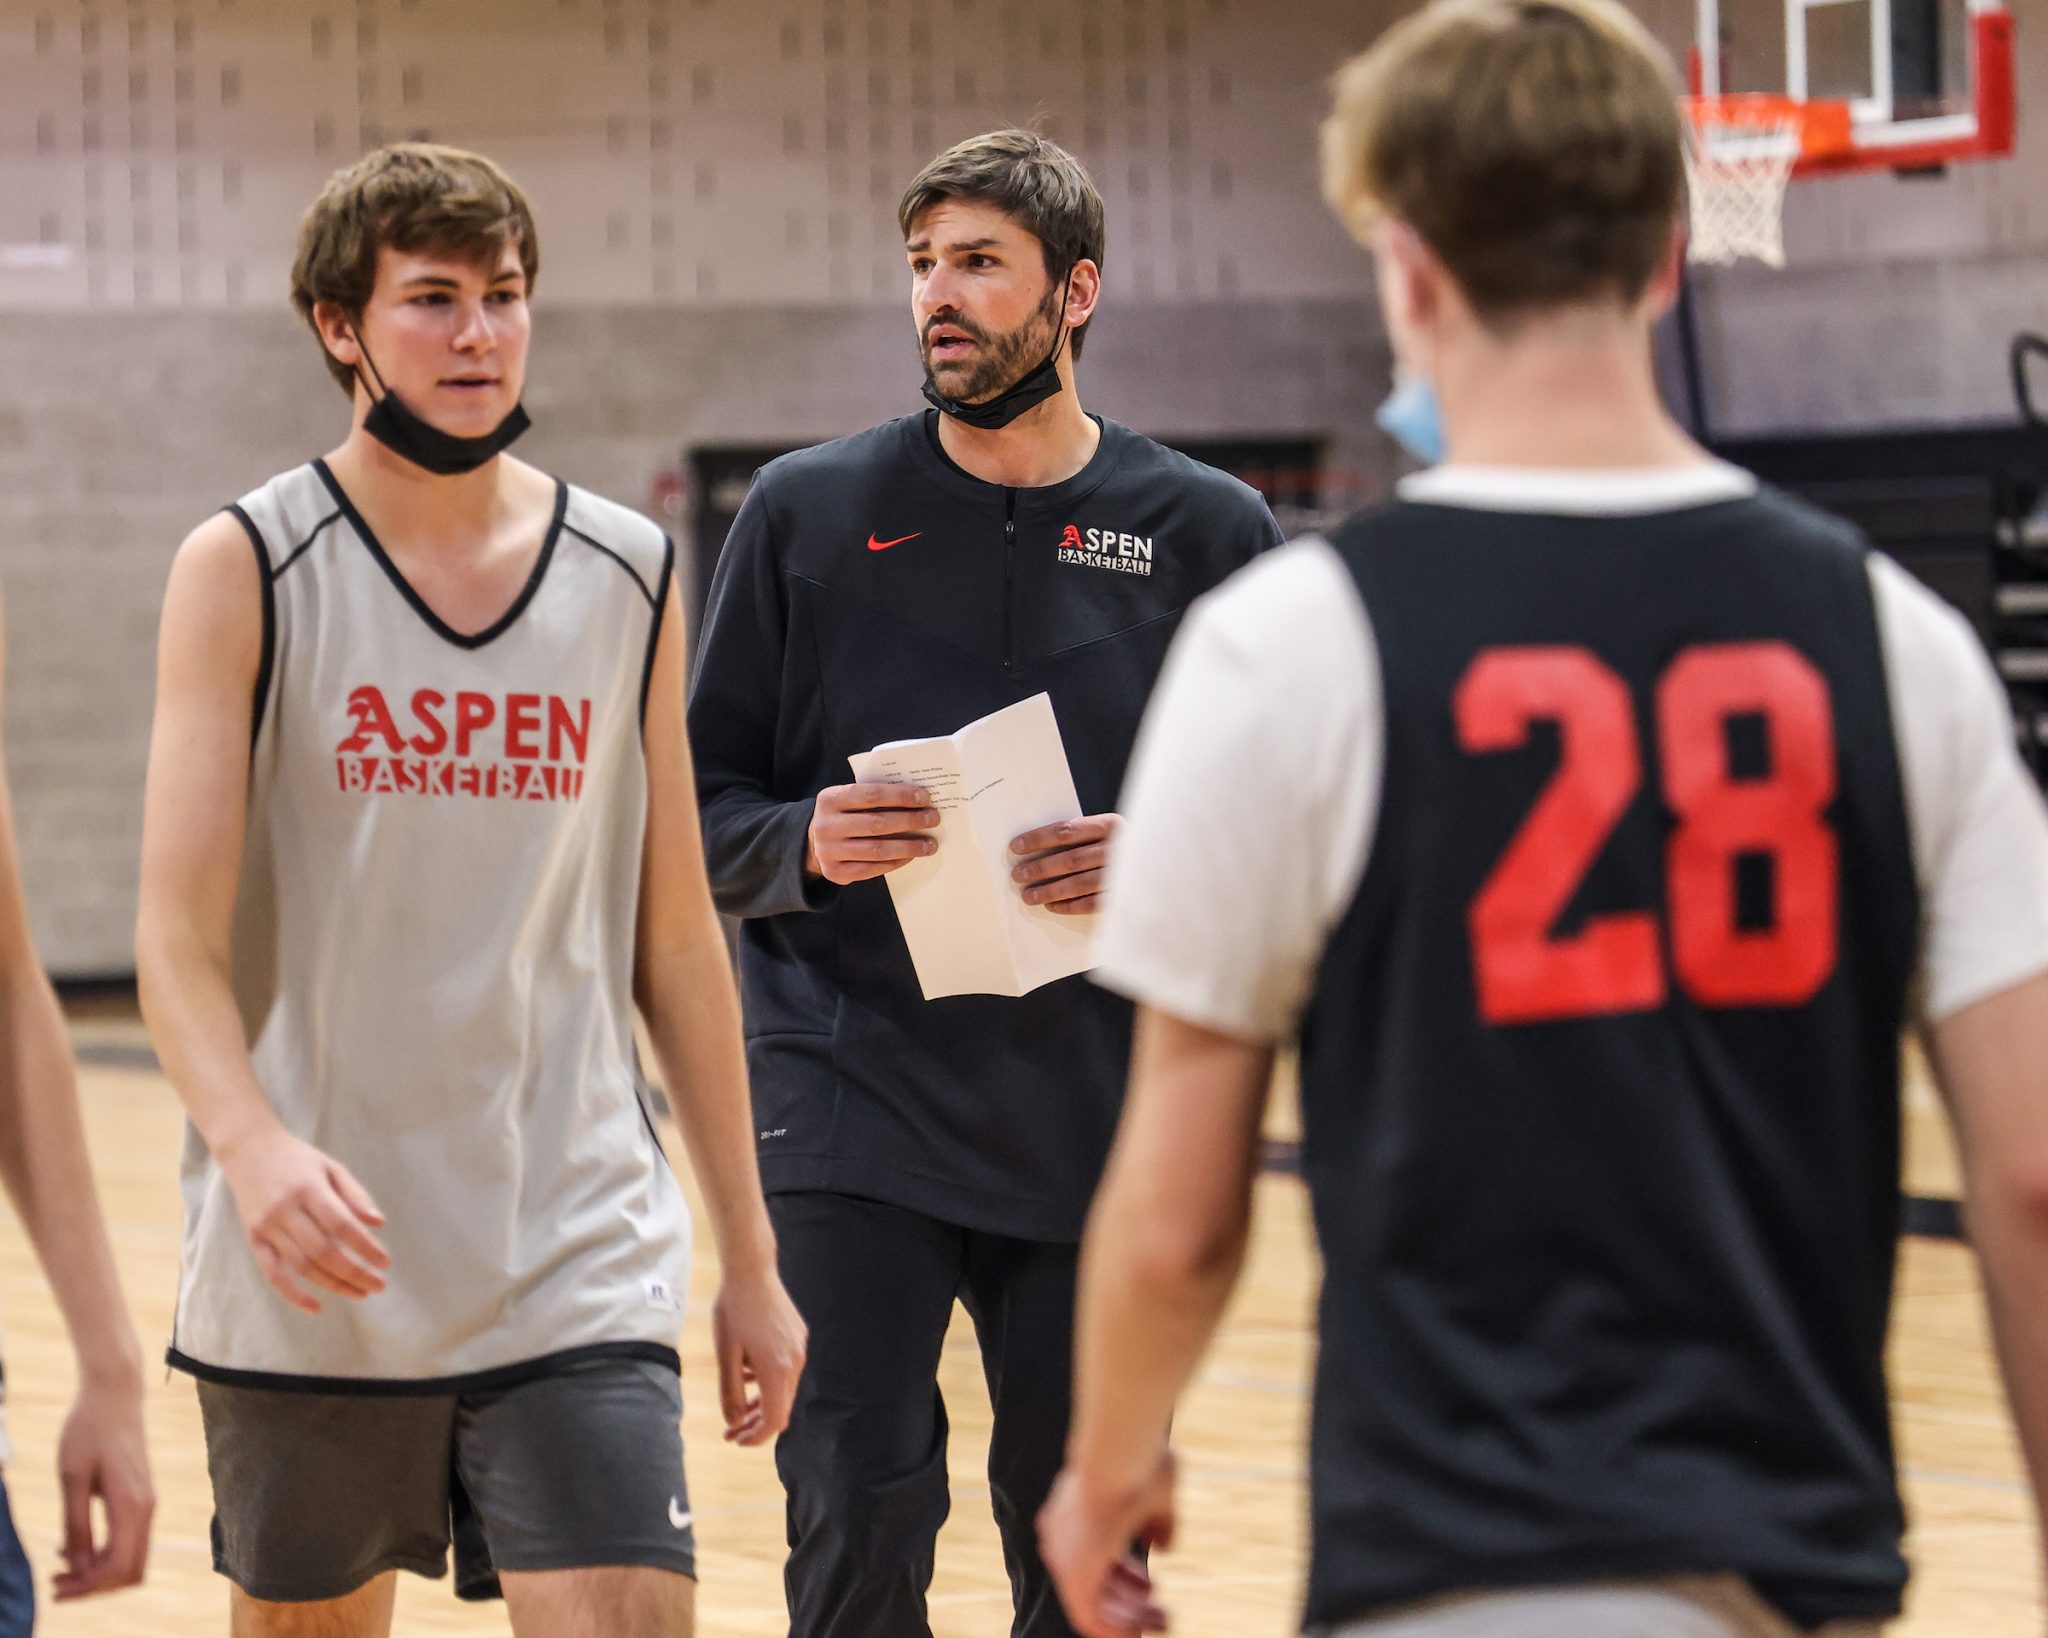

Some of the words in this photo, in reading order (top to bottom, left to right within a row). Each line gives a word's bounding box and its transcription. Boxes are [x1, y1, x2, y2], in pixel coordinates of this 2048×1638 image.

[1057, 548, 1152, 576] BASKETBALL
[1058, 524, 1153, 561] ASPEN
[336, 684, 591, 763] ASPEN
[336, 757, 584, 802] BASKETBALL
[1453, 640, 1838, 1026] 28
